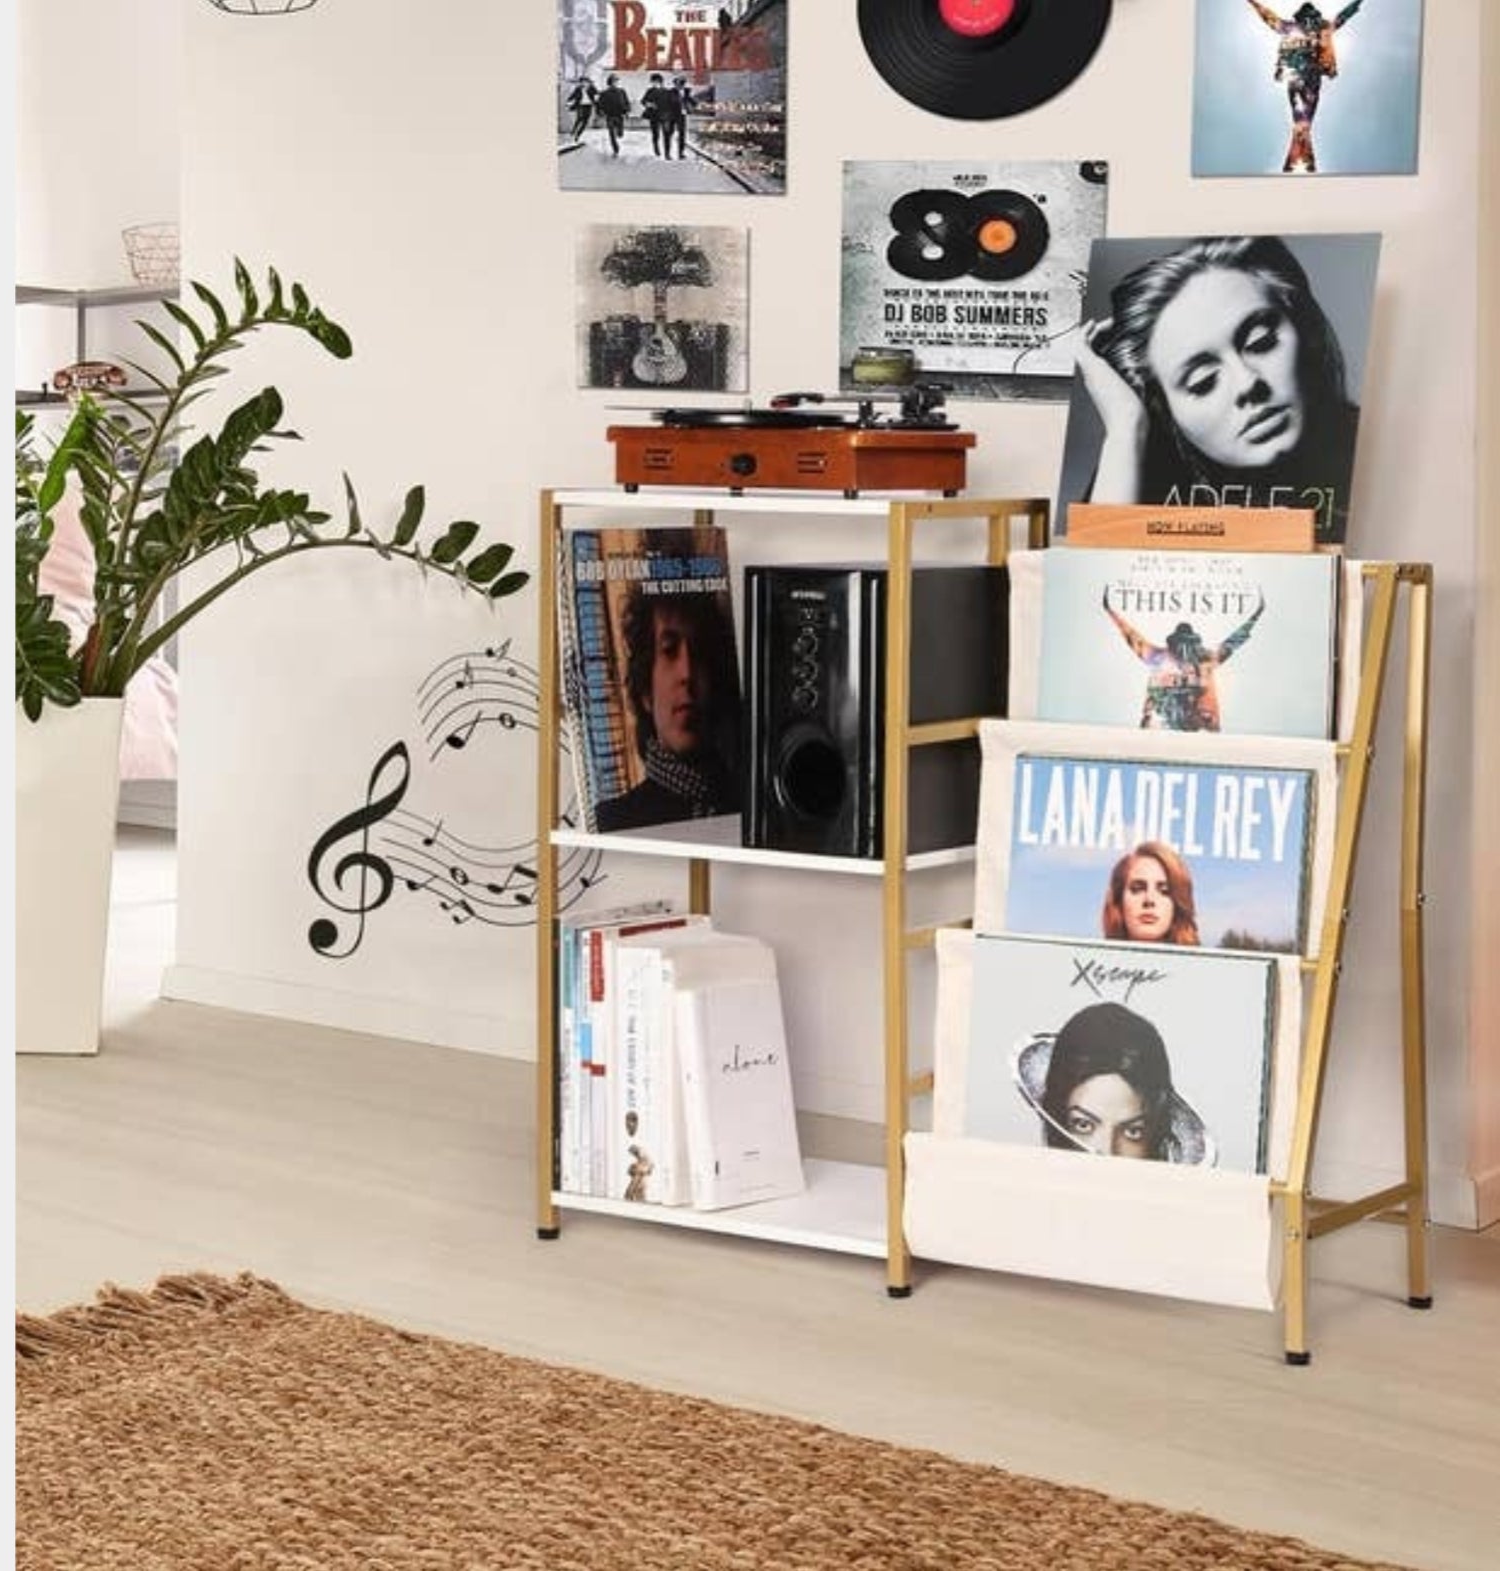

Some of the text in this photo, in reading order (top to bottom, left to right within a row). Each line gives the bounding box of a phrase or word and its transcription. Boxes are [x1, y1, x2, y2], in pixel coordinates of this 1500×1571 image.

[674, 10, 707, 23] THE
[884, 304, 1048, 326] DJ BOB SUMMERS
[1299, 486, 1336, 530] 21
[576, 559, 605, 582] BOB
[609, 558, 650, 581] DYLAN
[641, 577, 729, 595] THE CUTTING EDGE
[1115, 588, 1255, 614] THIS IS IT
[1019, 763, 1298, 862] LANA DEL REY
